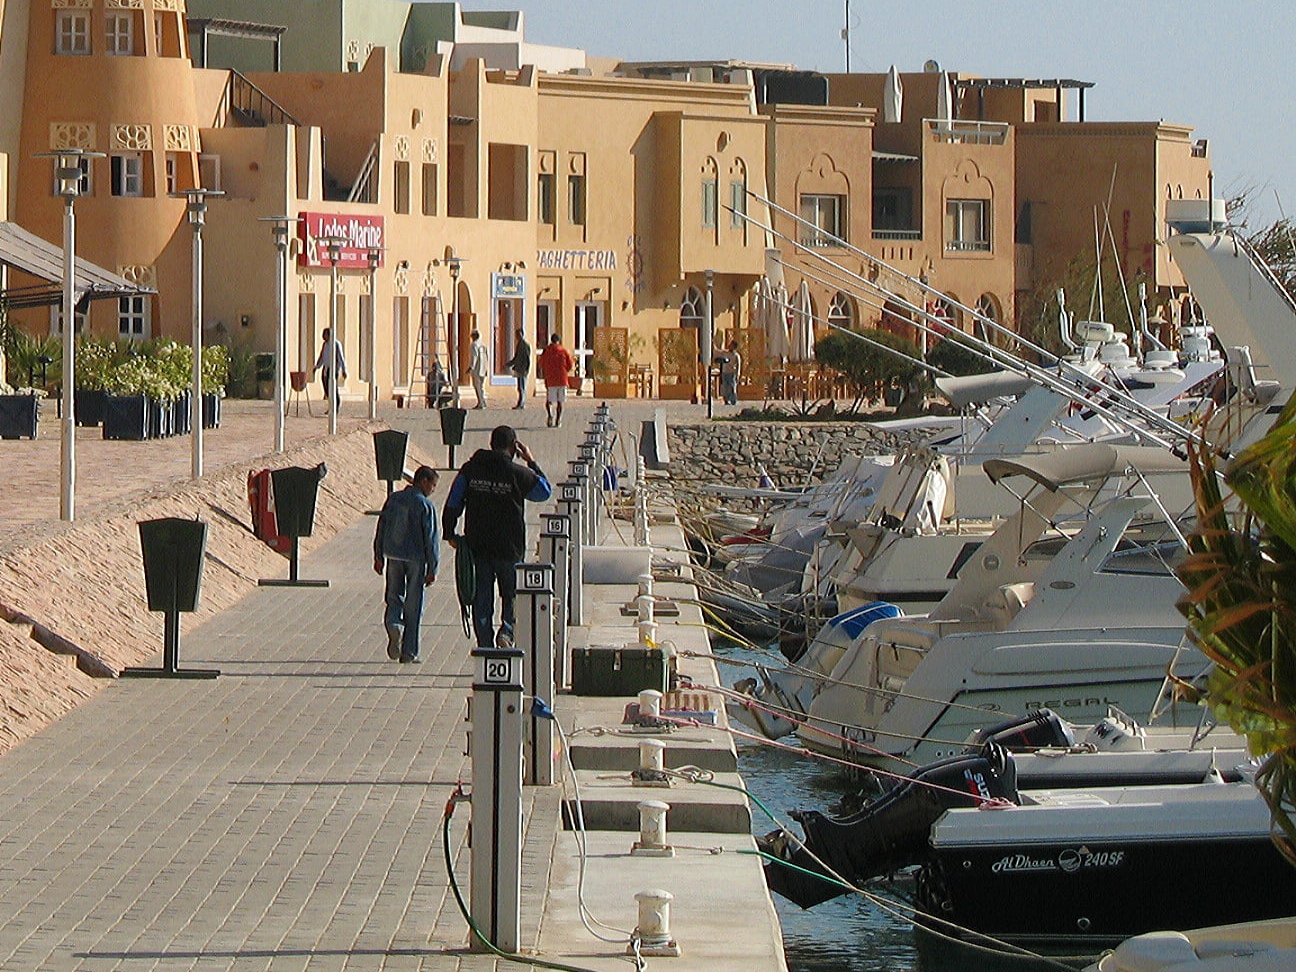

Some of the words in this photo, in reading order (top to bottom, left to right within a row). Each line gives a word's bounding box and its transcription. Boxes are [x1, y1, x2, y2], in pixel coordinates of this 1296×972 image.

[349, 219, 382, 248] Marine
[565, 489, 574, 497] 14
[550, 521, 560, 530] 16
[528, 573, 541, 584] 18
[488, 663, 507, 677] 20
[1025, 697, 1120, 710] REGAL
